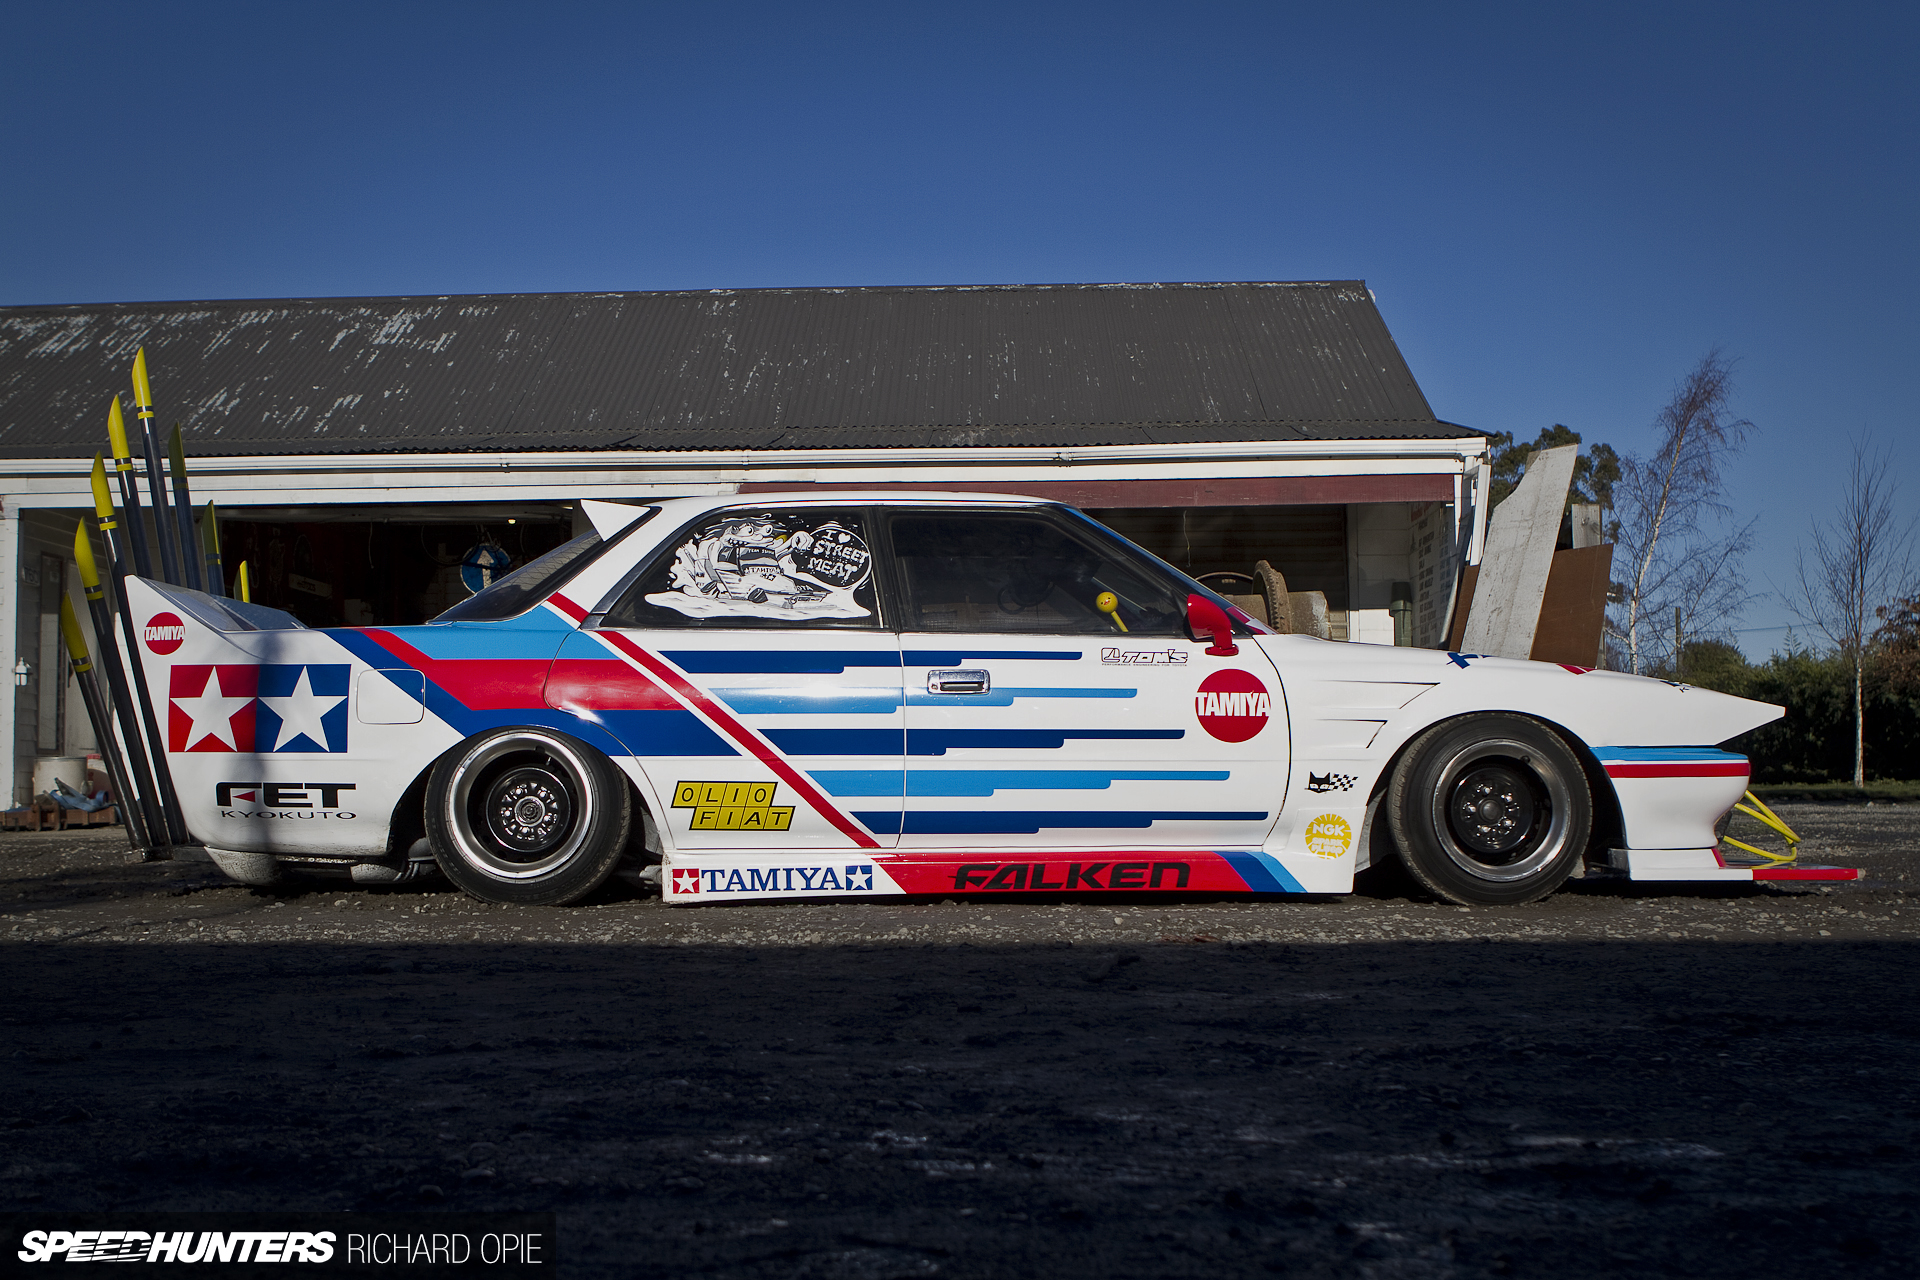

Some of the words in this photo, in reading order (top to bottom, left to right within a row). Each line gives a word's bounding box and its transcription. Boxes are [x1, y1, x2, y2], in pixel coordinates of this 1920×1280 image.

[822, 529, 838, 541] I
[813, 539, 869, 564] STREET
[807, 557, 858, 581] MEAT
[144, 625, 185, 641] TAMIYA
[1121, 648, 1189, 664] TOM'S
[1196, 691, 1272, 717] TAMIYA
[216, 781, 357, 809] FET
[681, 787, 767, 803] OLIO
[221, 810, 357, 820] KYOKUTO
[699, 811, 788, 826] FIAT
[1312, 823, 1346, 837] NGK
[1311, 836, 1345, 847] SPARK
[701, 867, 845, 893] TAMIYA
[948, 862, 1191, 890] FALKEN
